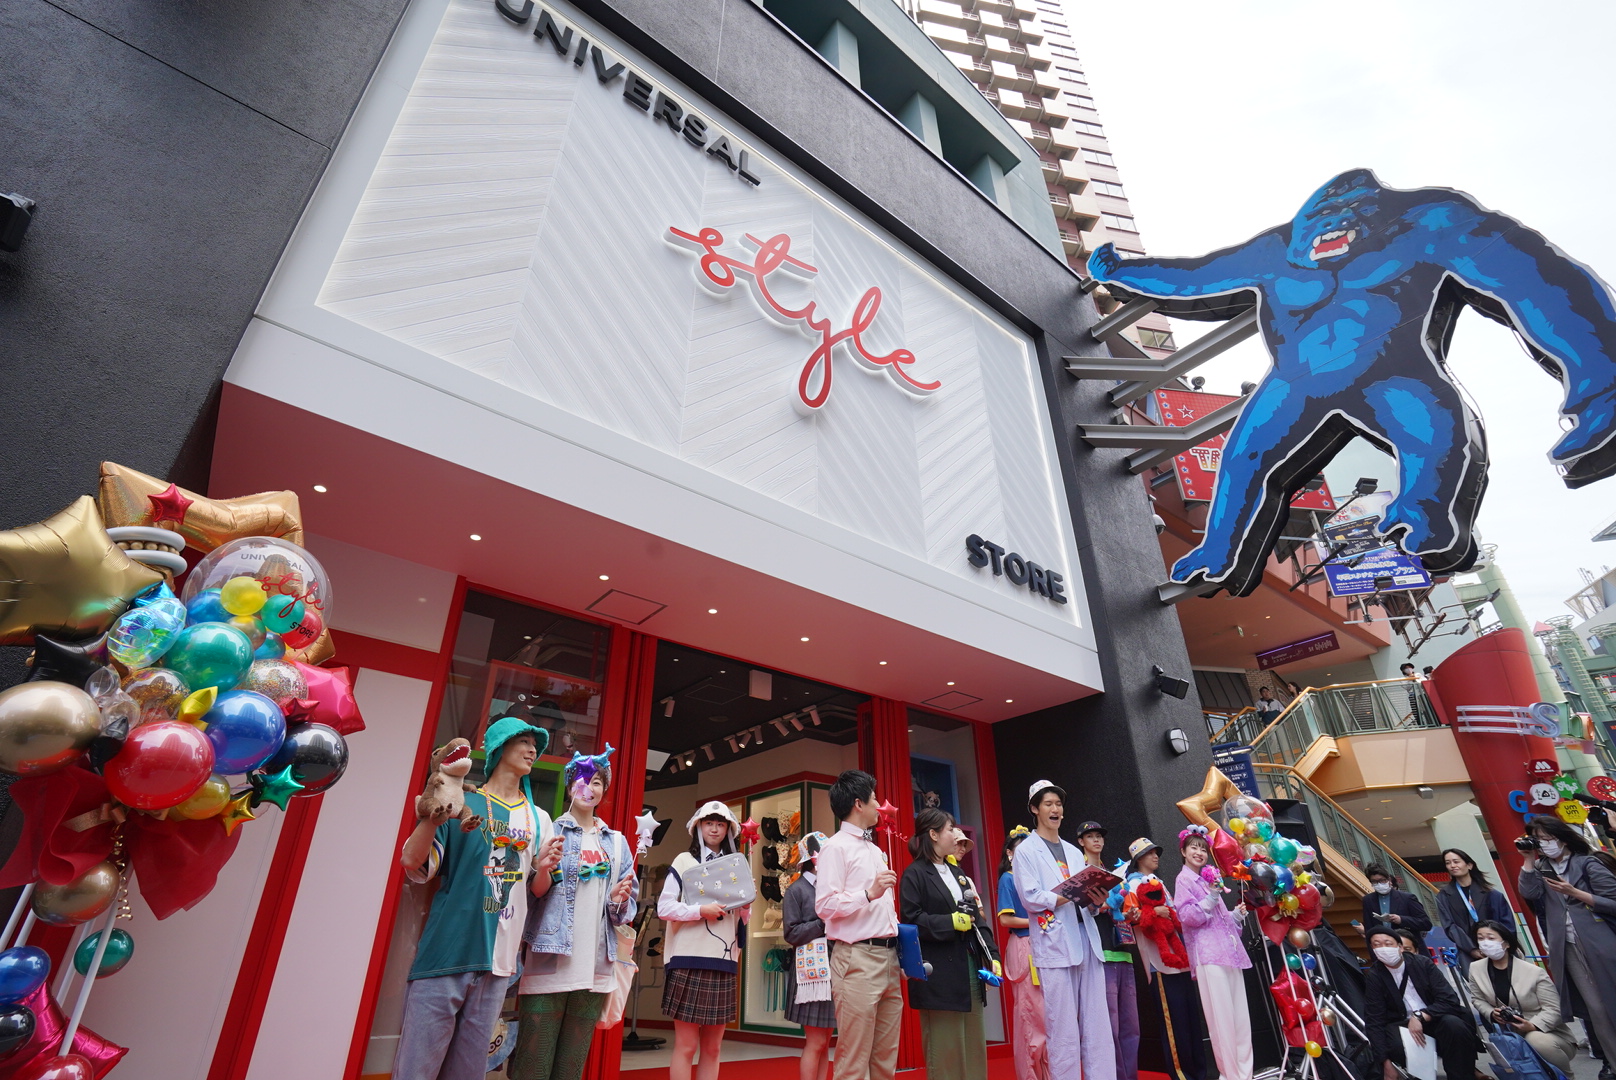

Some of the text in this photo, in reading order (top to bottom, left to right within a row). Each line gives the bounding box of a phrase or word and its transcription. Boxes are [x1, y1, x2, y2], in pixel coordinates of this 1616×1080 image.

[495, 0, 760, 187] UNIVERSAL
[667, 226, 942, 410] style
[240, 553, 304, 572] UNIVERSAL
[965, 533, 1068, 605] STORE
[254, 572, 325, 619] style
[289, 621, 314, 639] STORE
[1214, 757, 1234, 765] tyWalk
